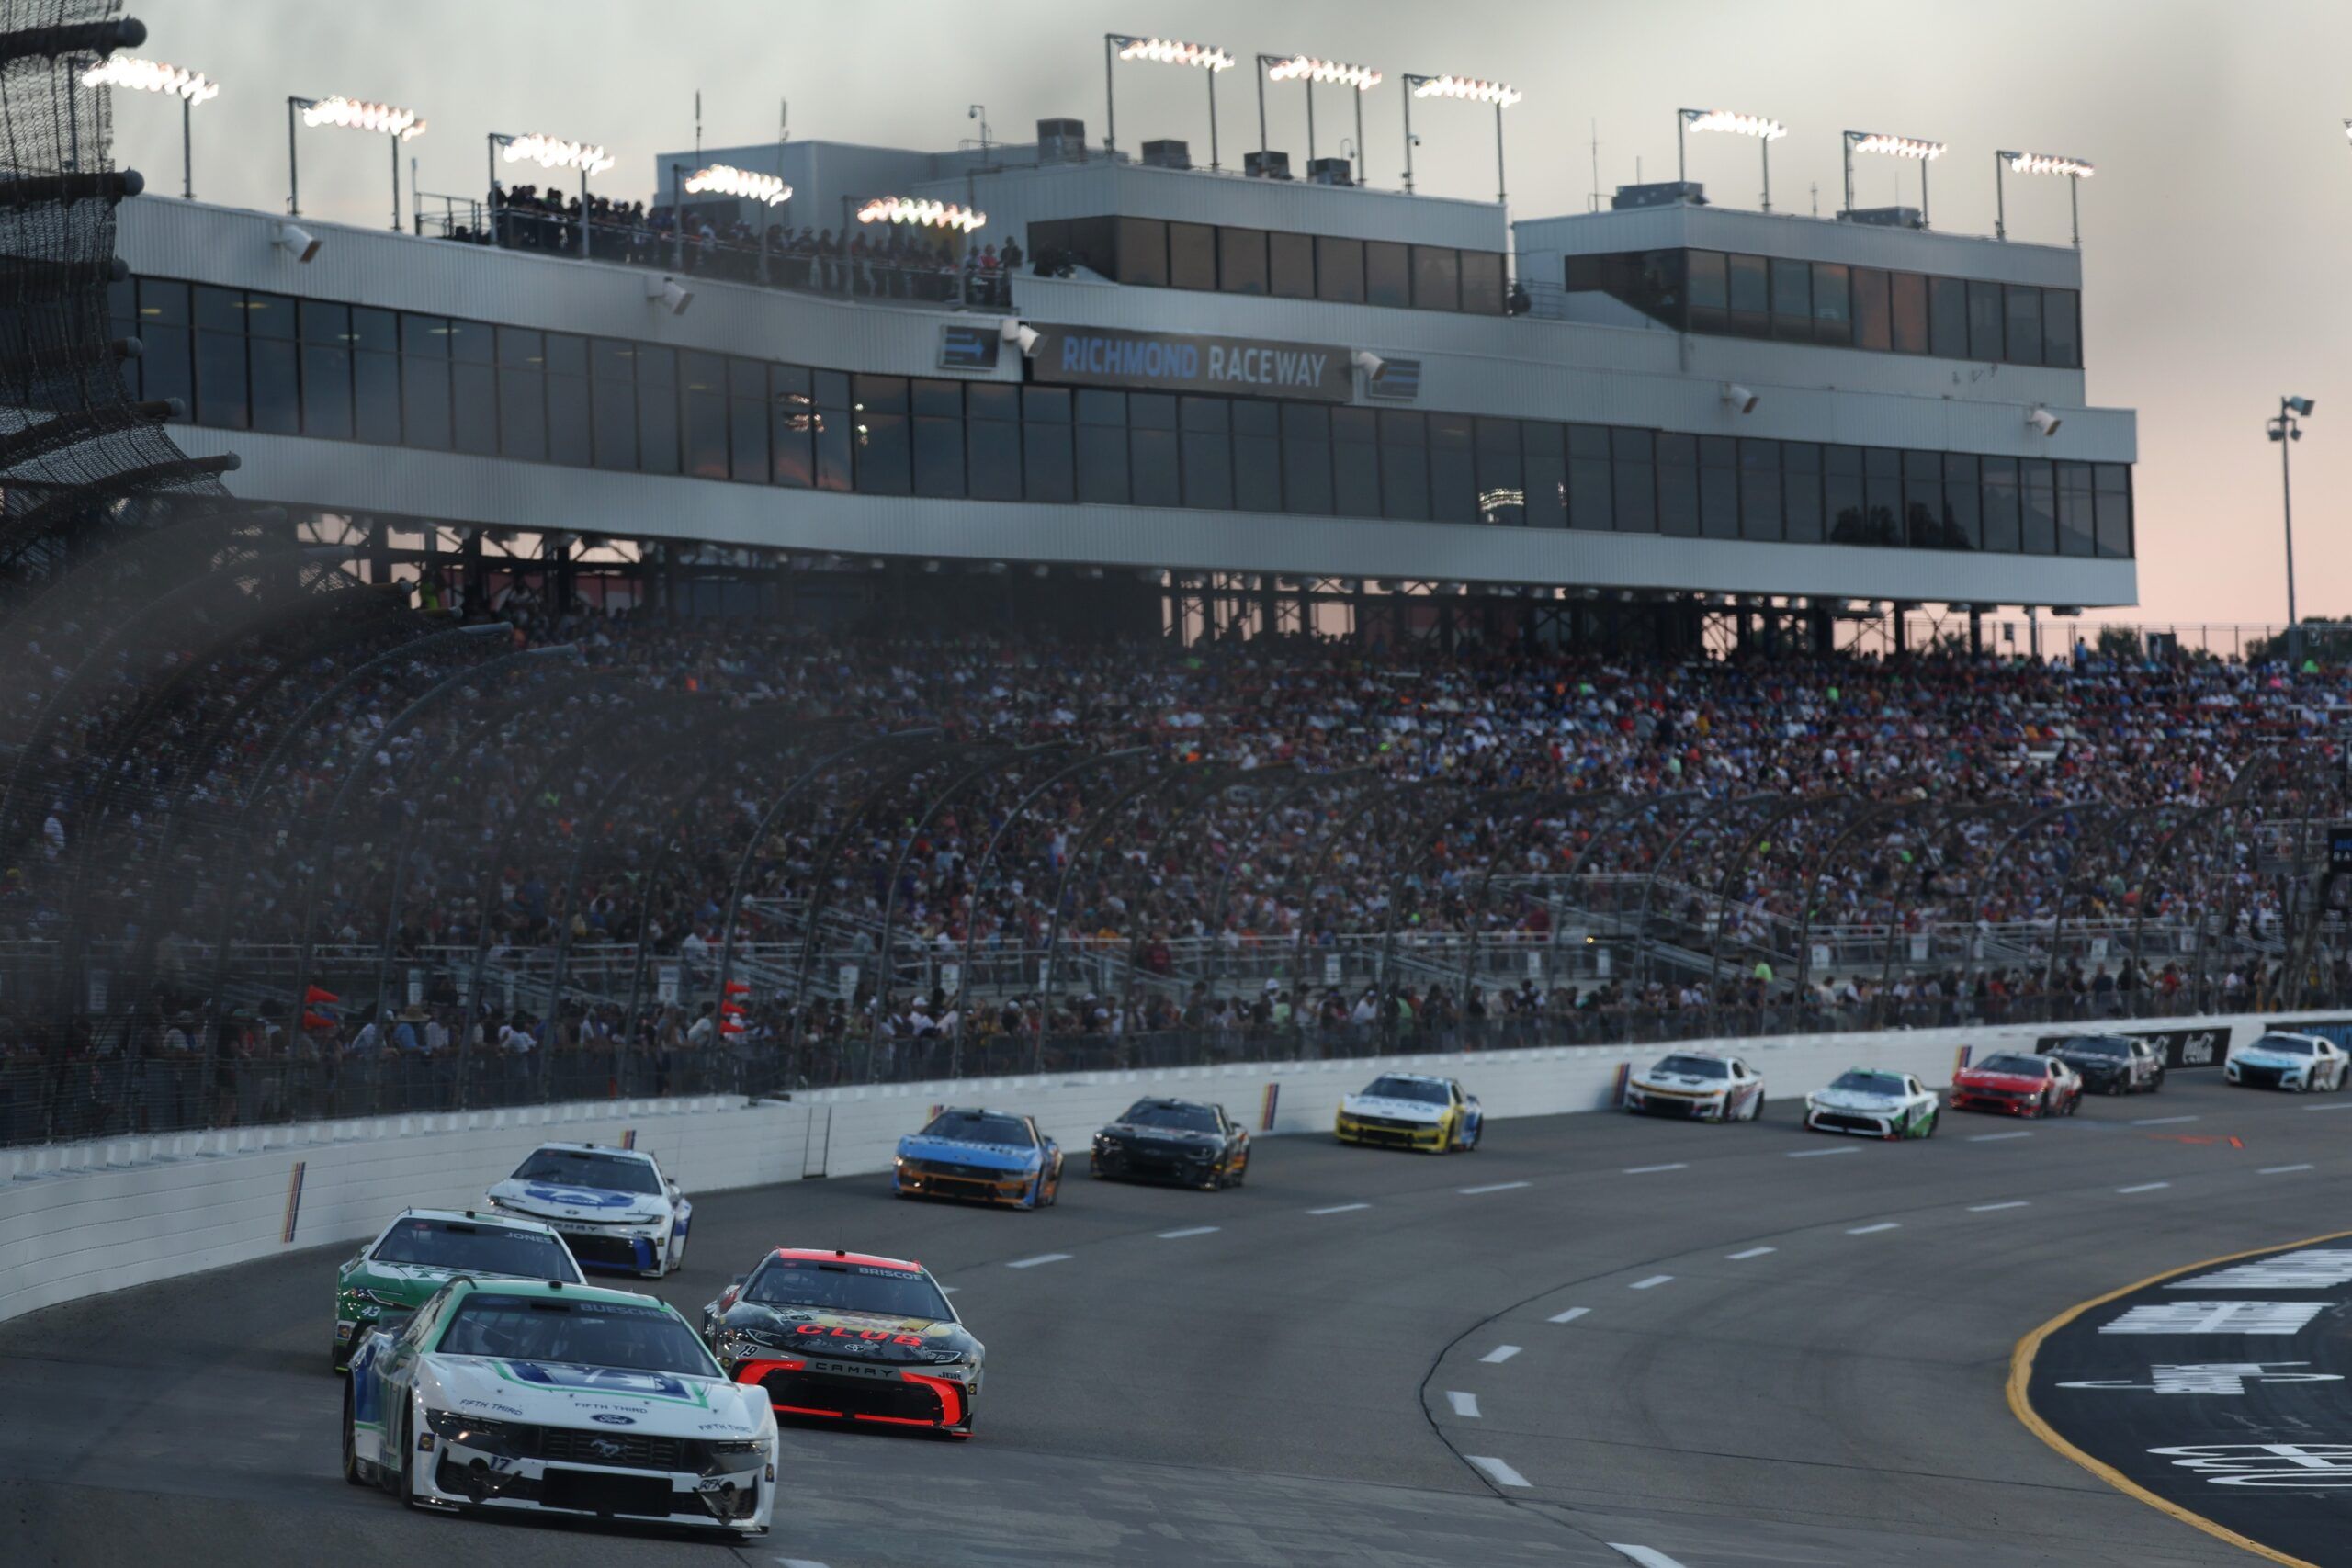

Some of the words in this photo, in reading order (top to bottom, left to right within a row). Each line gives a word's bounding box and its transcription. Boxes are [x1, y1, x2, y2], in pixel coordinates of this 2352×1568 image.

[1061, 336, 1199, 379] RICHMOND
[1208, 345, 1327, 387] RACEWAY
[504, 1232, 553, 1244] JONES
[859, 1267, 923, 1280] BRISCOE
[361, 1305, 381, 1317] 43
[796, 1324, 922, 1347] CLUB
[739, 1344, 758, 1358] 19
[815, 1362, 896, 1377] CAMRY
[460, 1399, 490, 1410] FIFTH
[492, 1404, 523, 1416] THIRD
[575, 1402, 608, 1410] FIFTH
[616, 1404, 648, 1414] THIRD
[697, 1424, 723, 1432] FIFTH
[490, 1456, 512, 1470] 17
[699, 1478, 723, 1490] RFK
